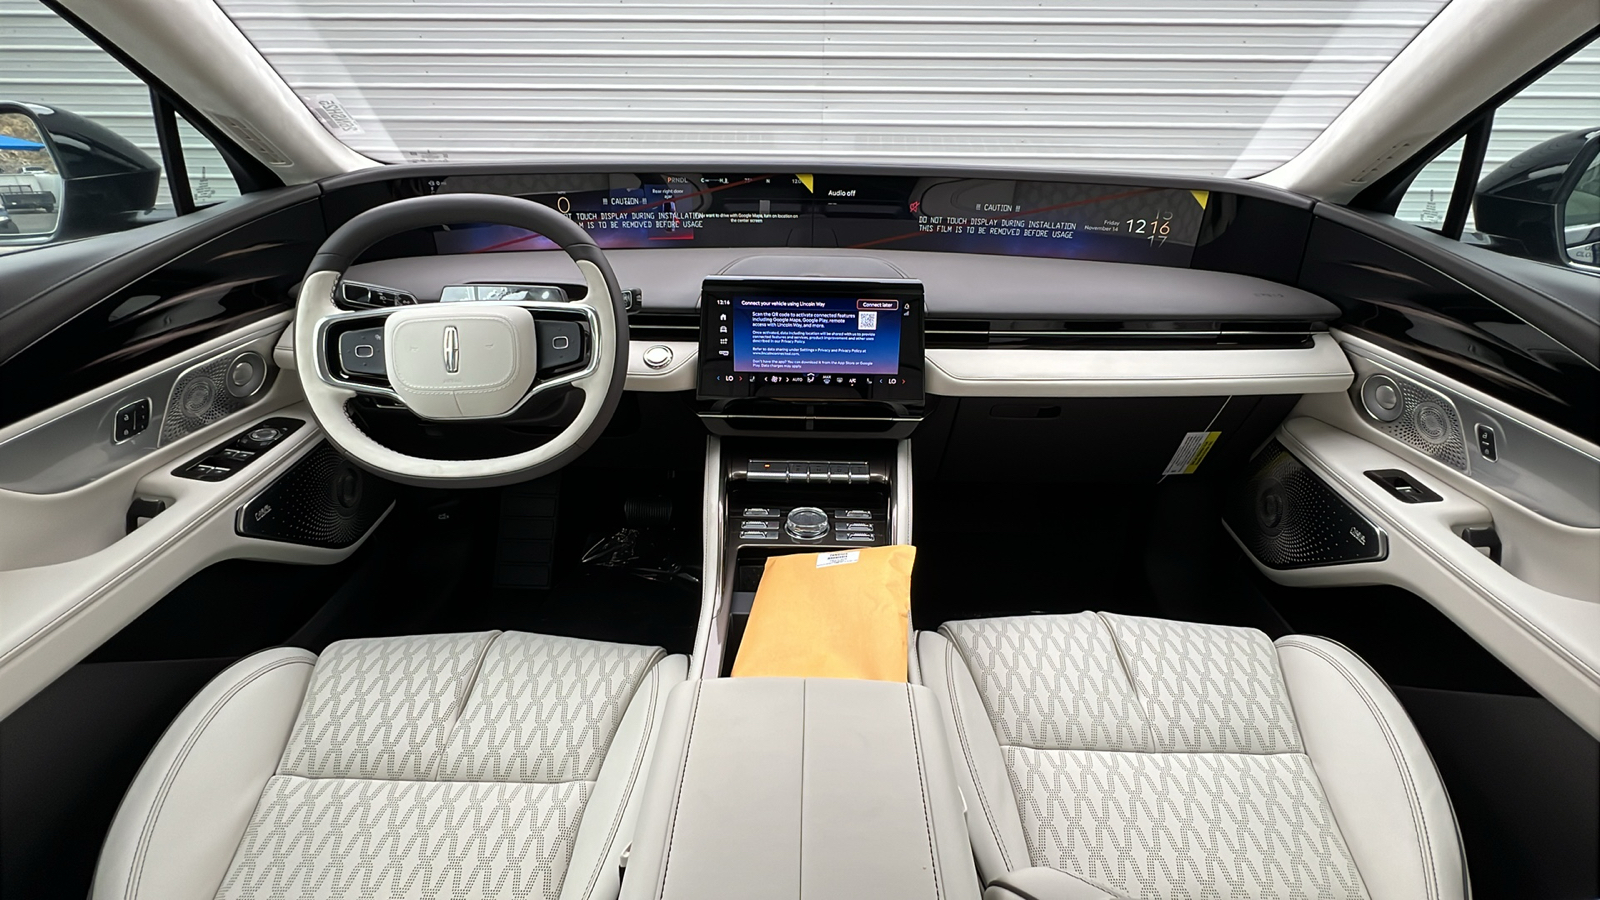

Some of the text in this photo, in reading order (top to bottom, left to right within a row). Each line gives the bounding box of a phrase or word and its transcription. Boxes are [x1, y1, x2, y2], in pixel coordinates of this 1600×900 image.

[1002, 219, 1025, 227] DURING
[1028, 221, 1076, 230] INSTALLATION
[1126, 218, 1146, 234] 12
[1150, 220, 1170, 235] 16
[1024, 229, 1048, 237] BEFORE
[1147, 235, 1168, 248] 17
